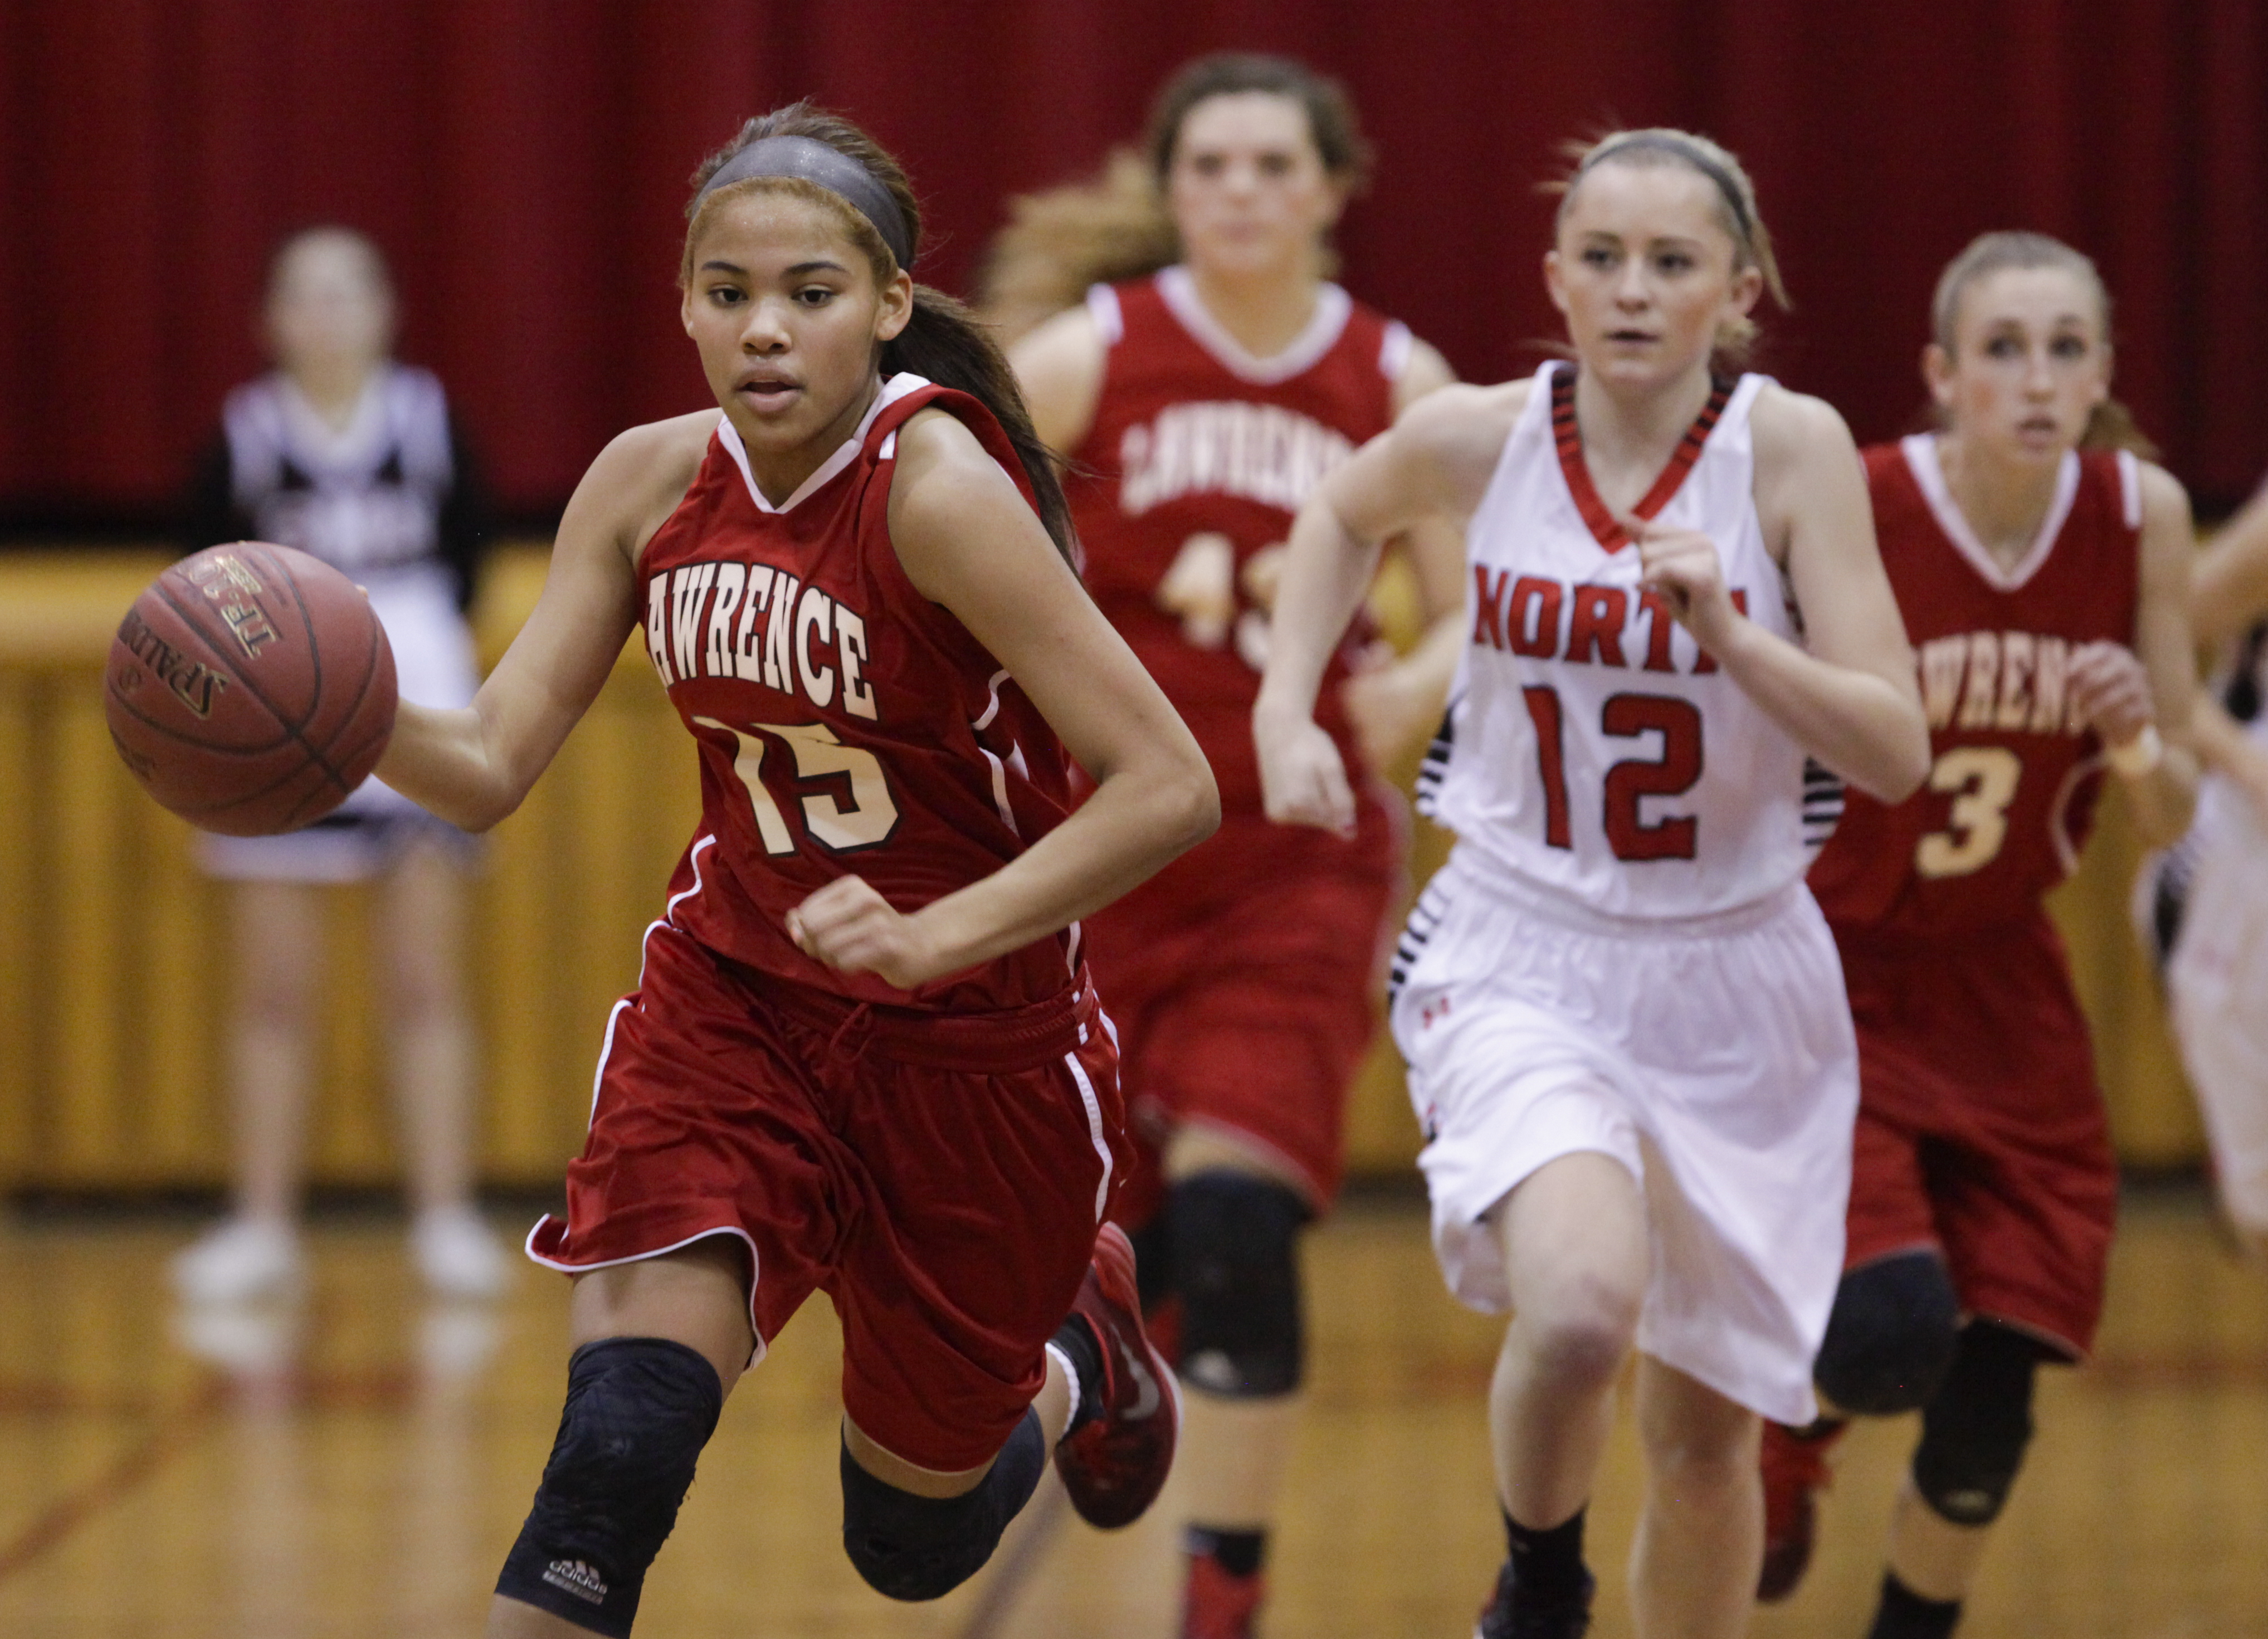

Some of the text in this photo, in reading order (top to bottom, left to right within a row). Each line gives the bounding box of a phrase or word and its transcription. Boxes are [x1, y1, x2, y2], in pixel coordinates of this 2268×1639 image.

[646, 561, 879, 722] AWRENCE
[691, 714, 899, 857] 15
[1522, 683, 1705, 861] 12
[1914, 745, 2022, 879] 3
